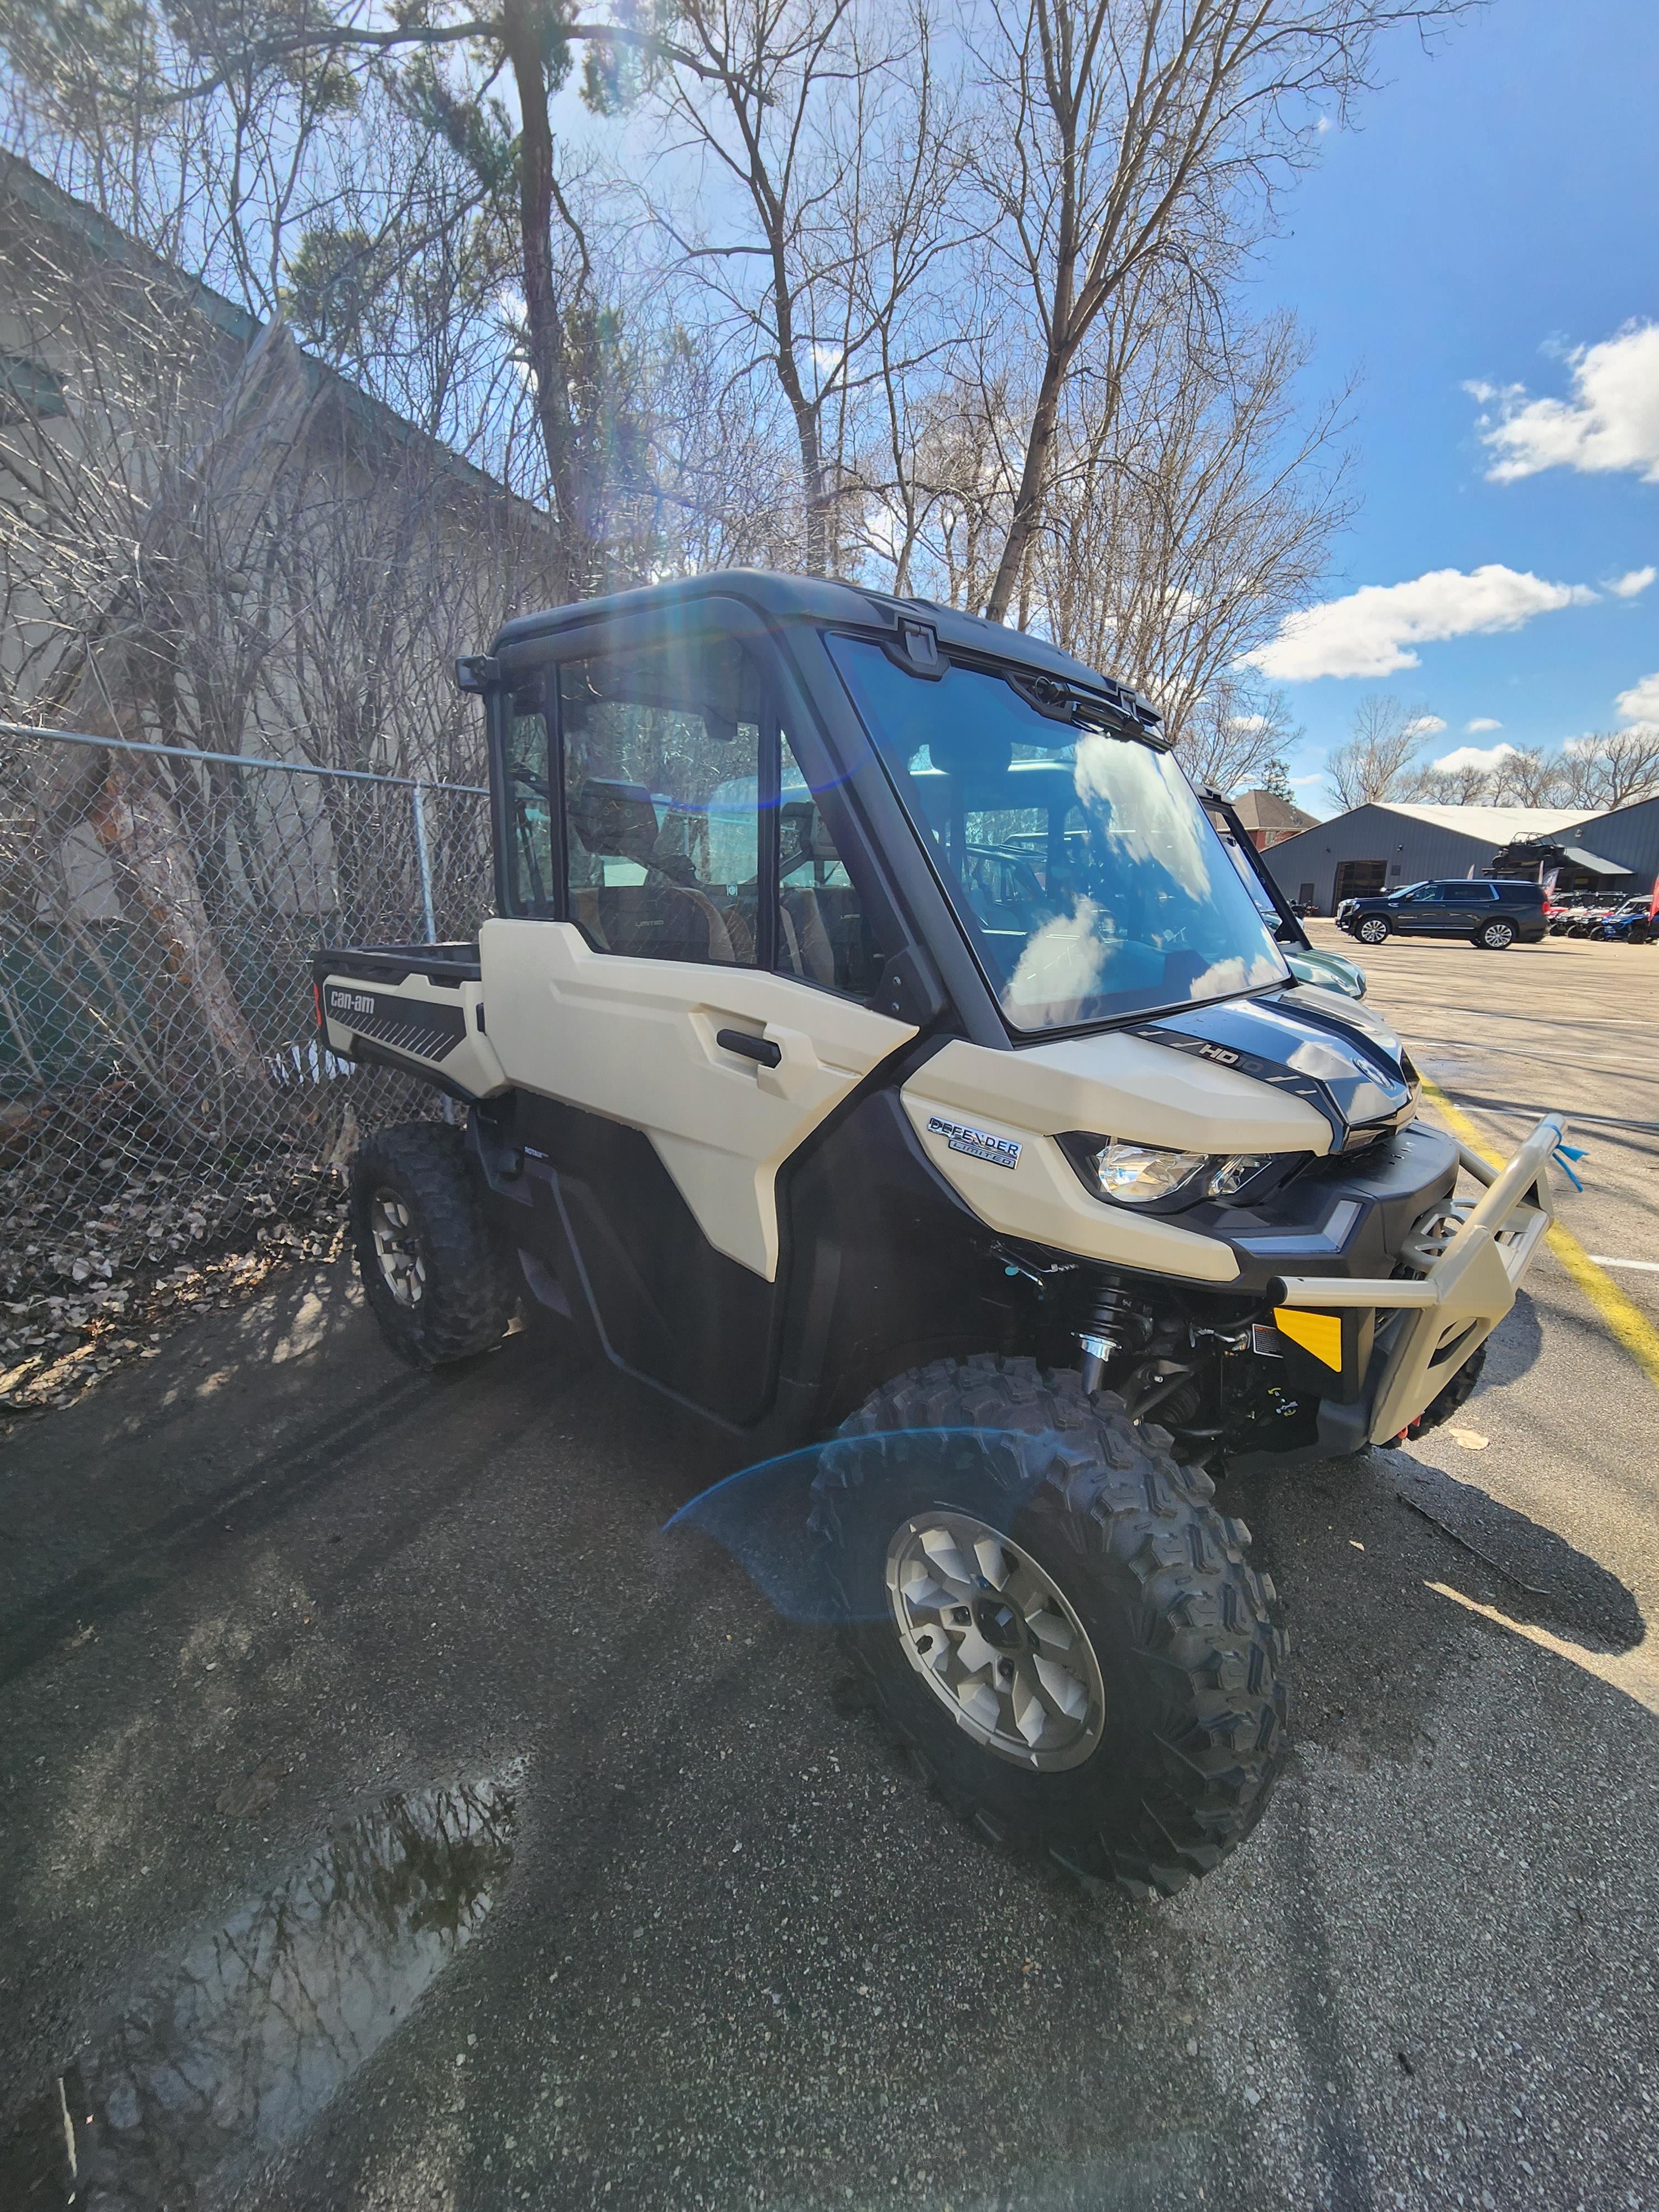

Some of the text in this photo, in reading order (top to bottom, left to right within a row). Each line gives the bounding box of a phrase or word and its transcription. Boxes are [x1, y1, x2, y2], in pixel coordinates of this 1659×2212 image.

[331, 991, 374, 1014] can-am
[930, 1118, 1019, 1156] DEFENDER
[953, 1142, 1011, 1165] LIMITED
